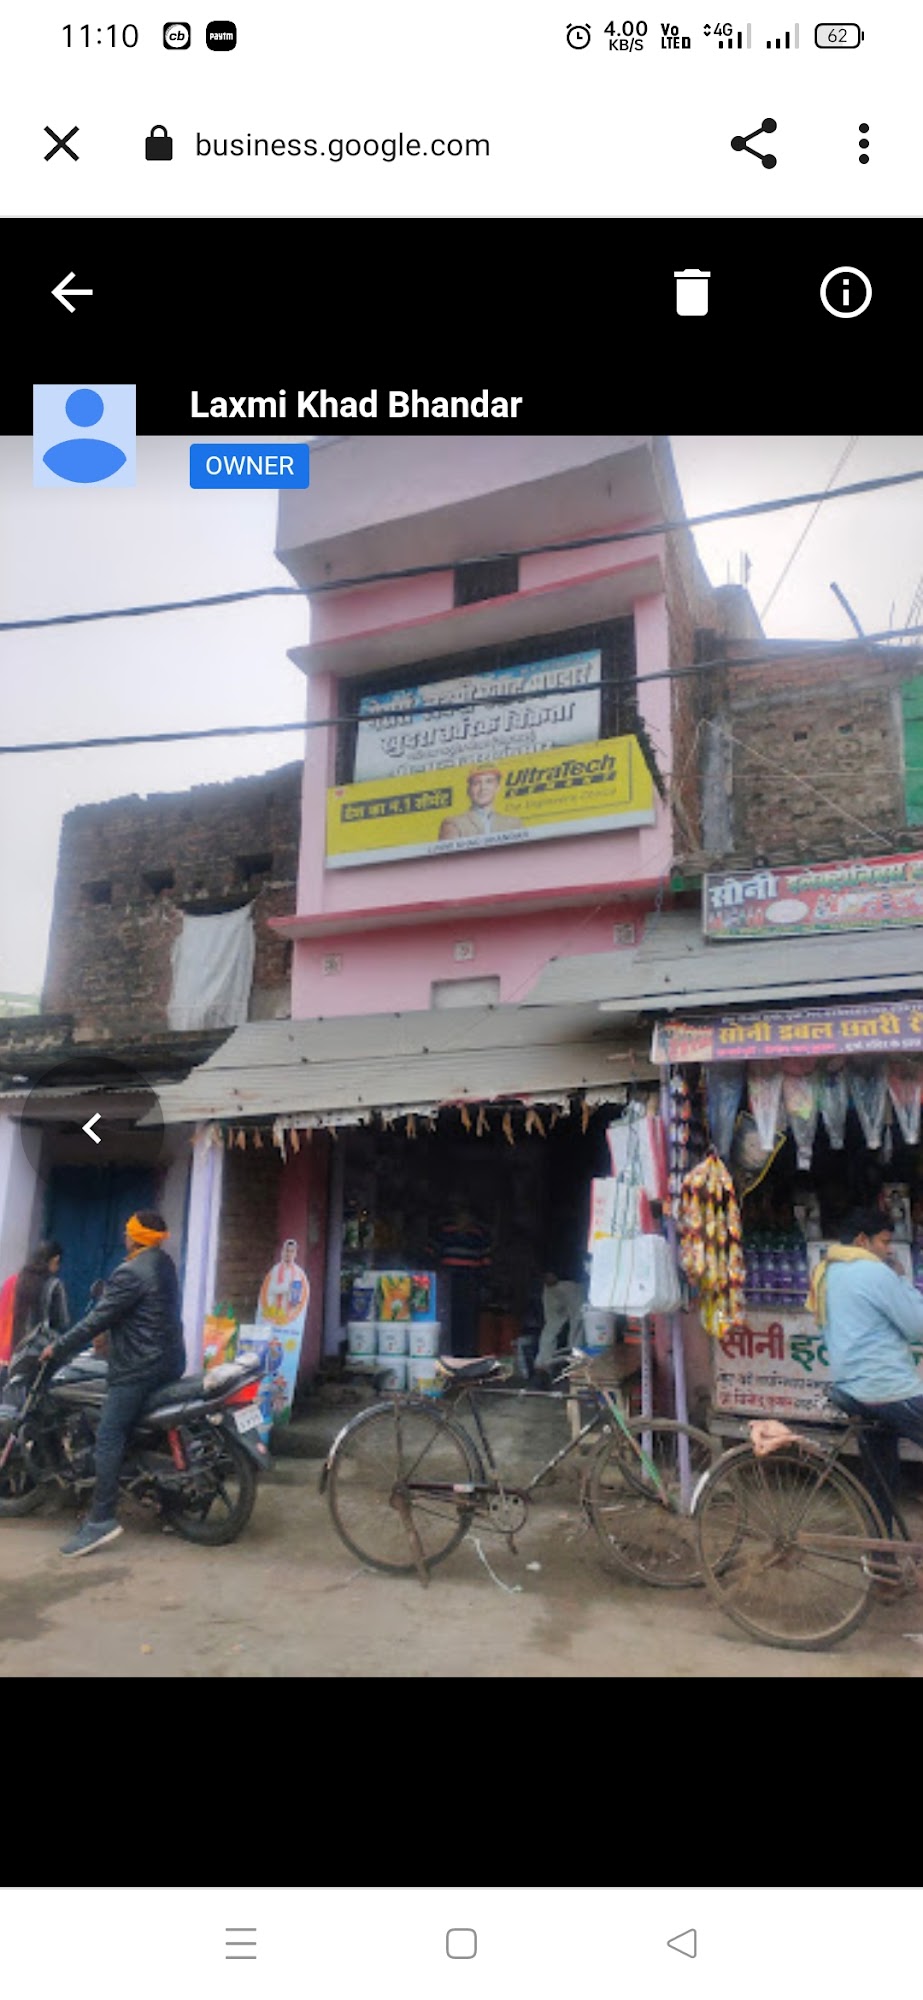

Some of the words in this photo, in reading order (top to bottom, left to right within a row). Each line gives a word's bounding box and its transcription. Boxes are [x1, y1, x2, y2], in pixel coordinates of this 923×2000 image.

[504, 753, 617, 787] UltraTech
[708, 870, 779, 909] सोनी
[719, 1020, 771, 1044] सोनी
[719, 1321, 785, 1360] सोनी
